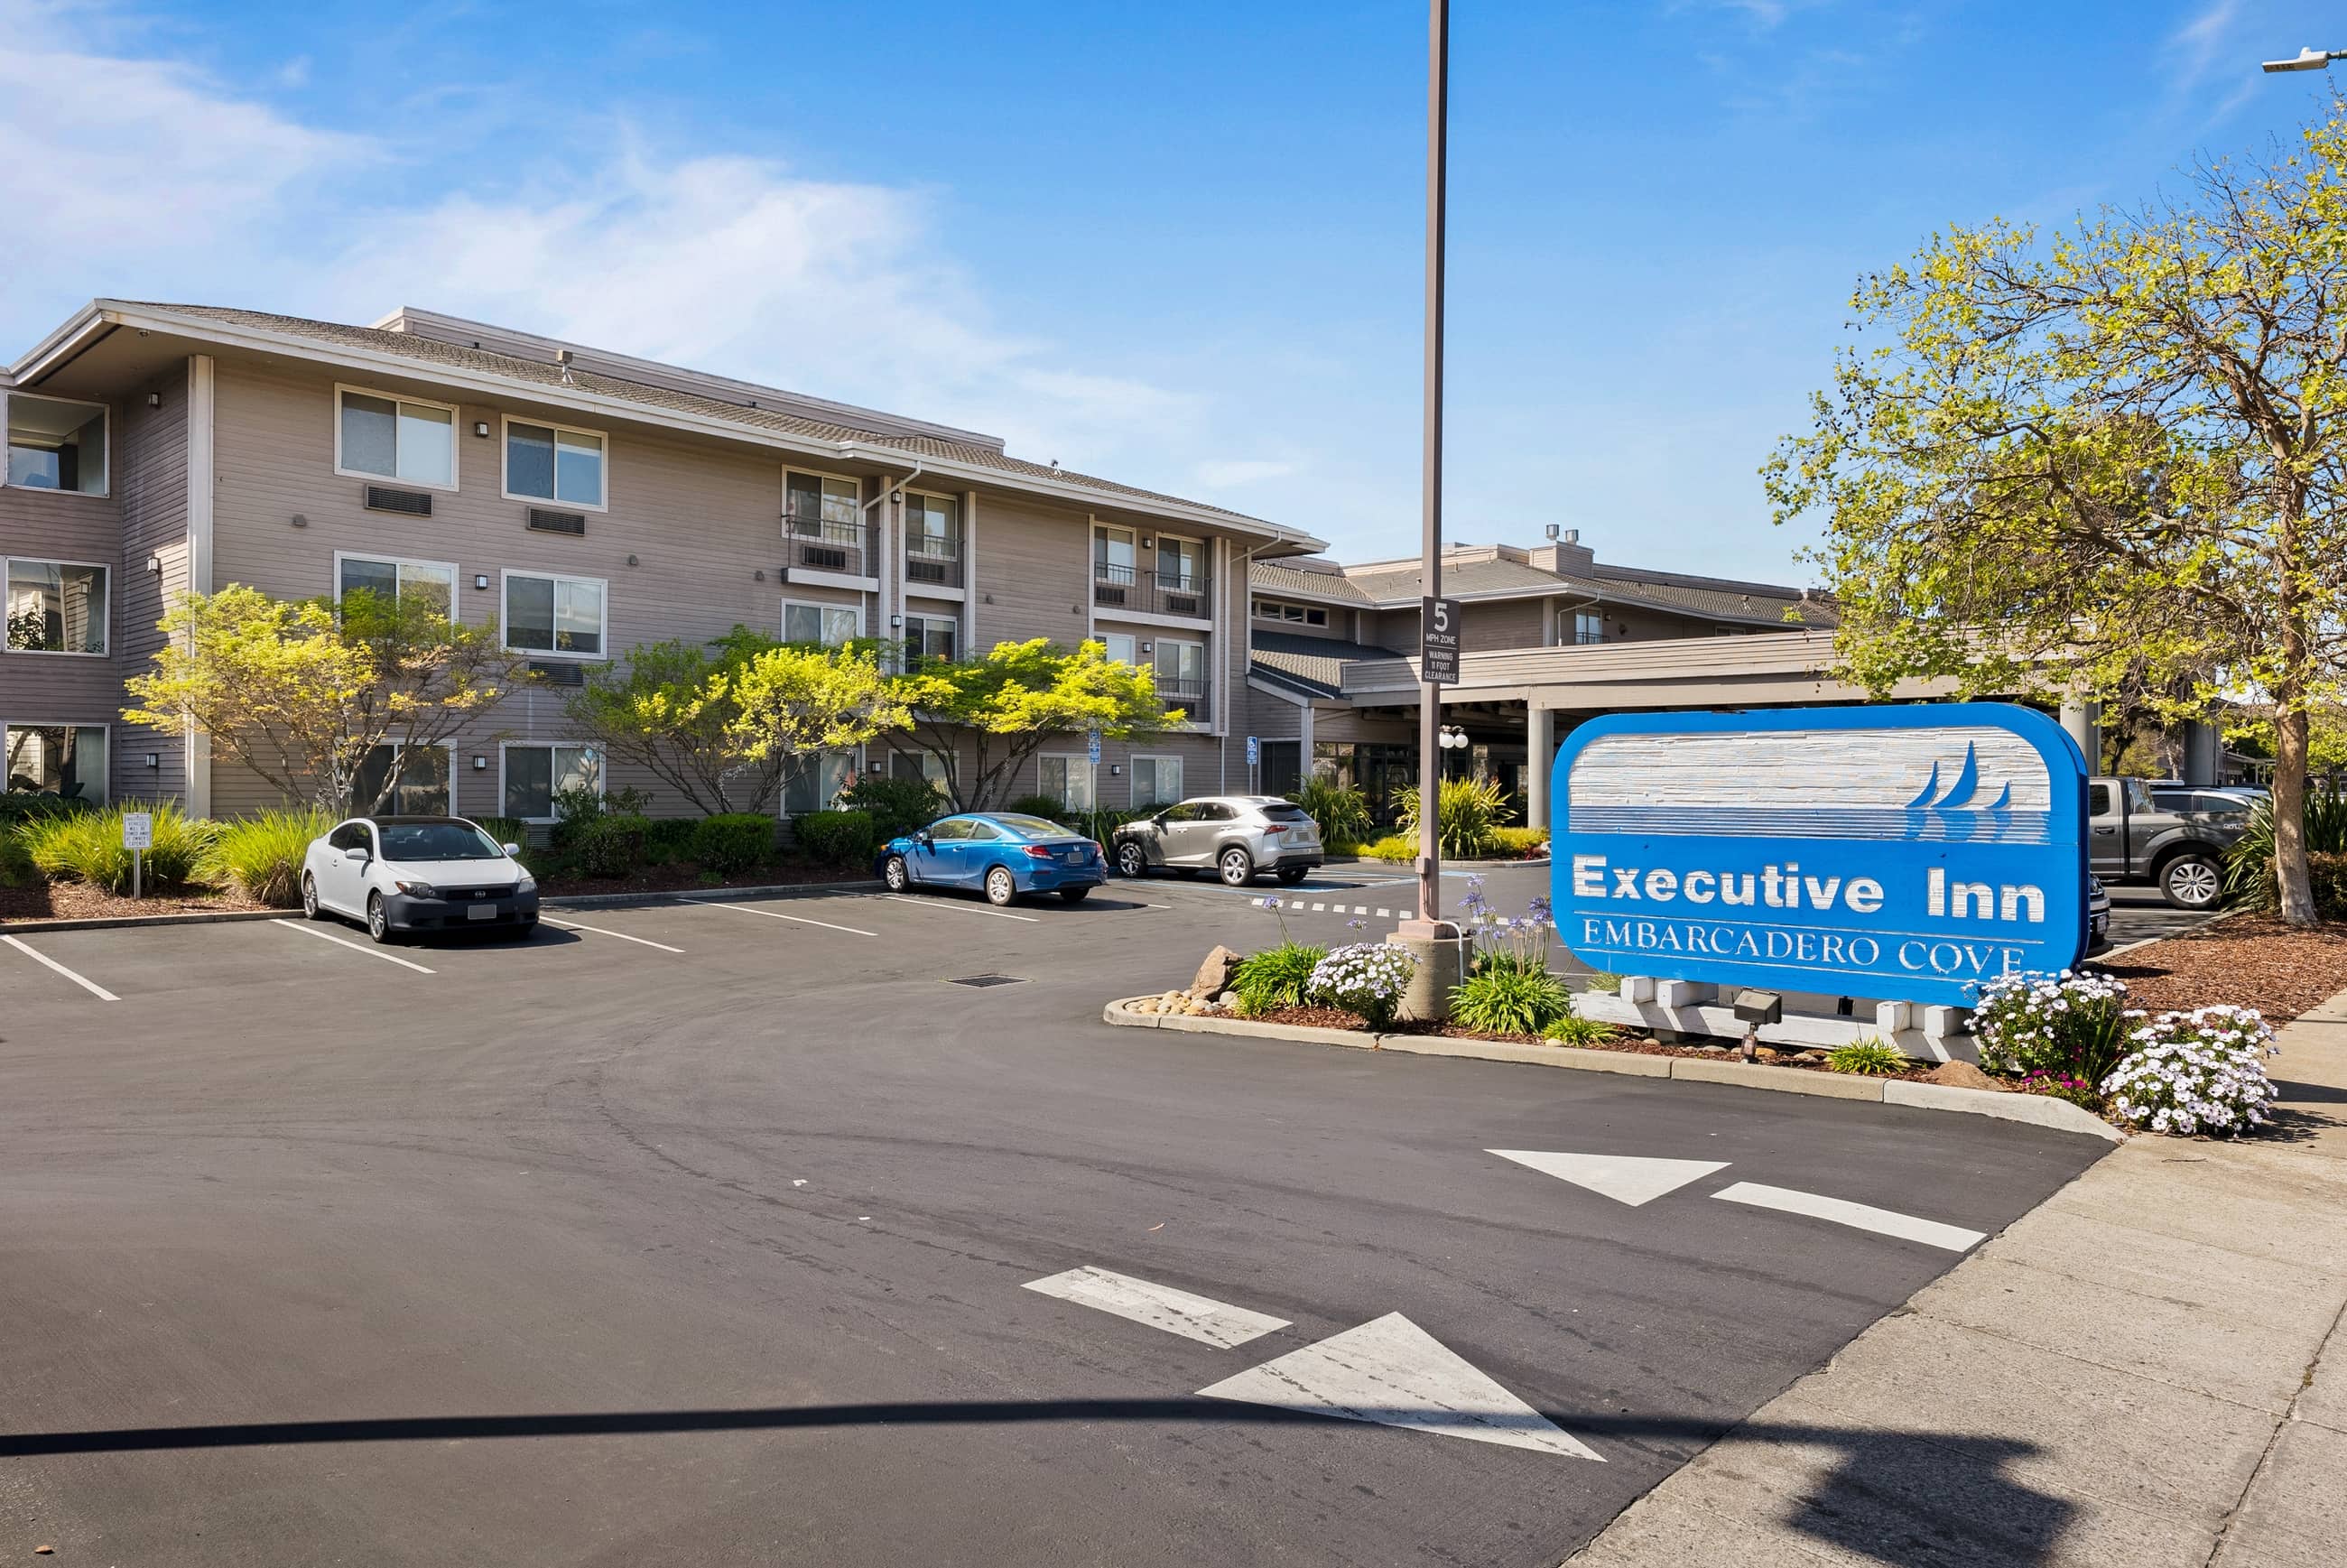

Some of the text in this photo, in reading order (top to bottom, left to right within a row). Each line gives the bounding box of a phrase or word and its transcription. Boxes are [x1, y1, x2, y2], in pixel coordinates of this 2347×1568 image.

[1434, 602, 1448, 632] 5
[1425, 633, 1456, 645] MPH ZONE
[1429, 650, 1453, 661] WARNING
[1436, 661, 1450, 672] FOOT
[1424, 671, 1456, 682] CLEARANCE
[1572, 853, 2045, 923] Executive Inn
[1582, 918, 2025, 977] EMBARCADERO COVE
